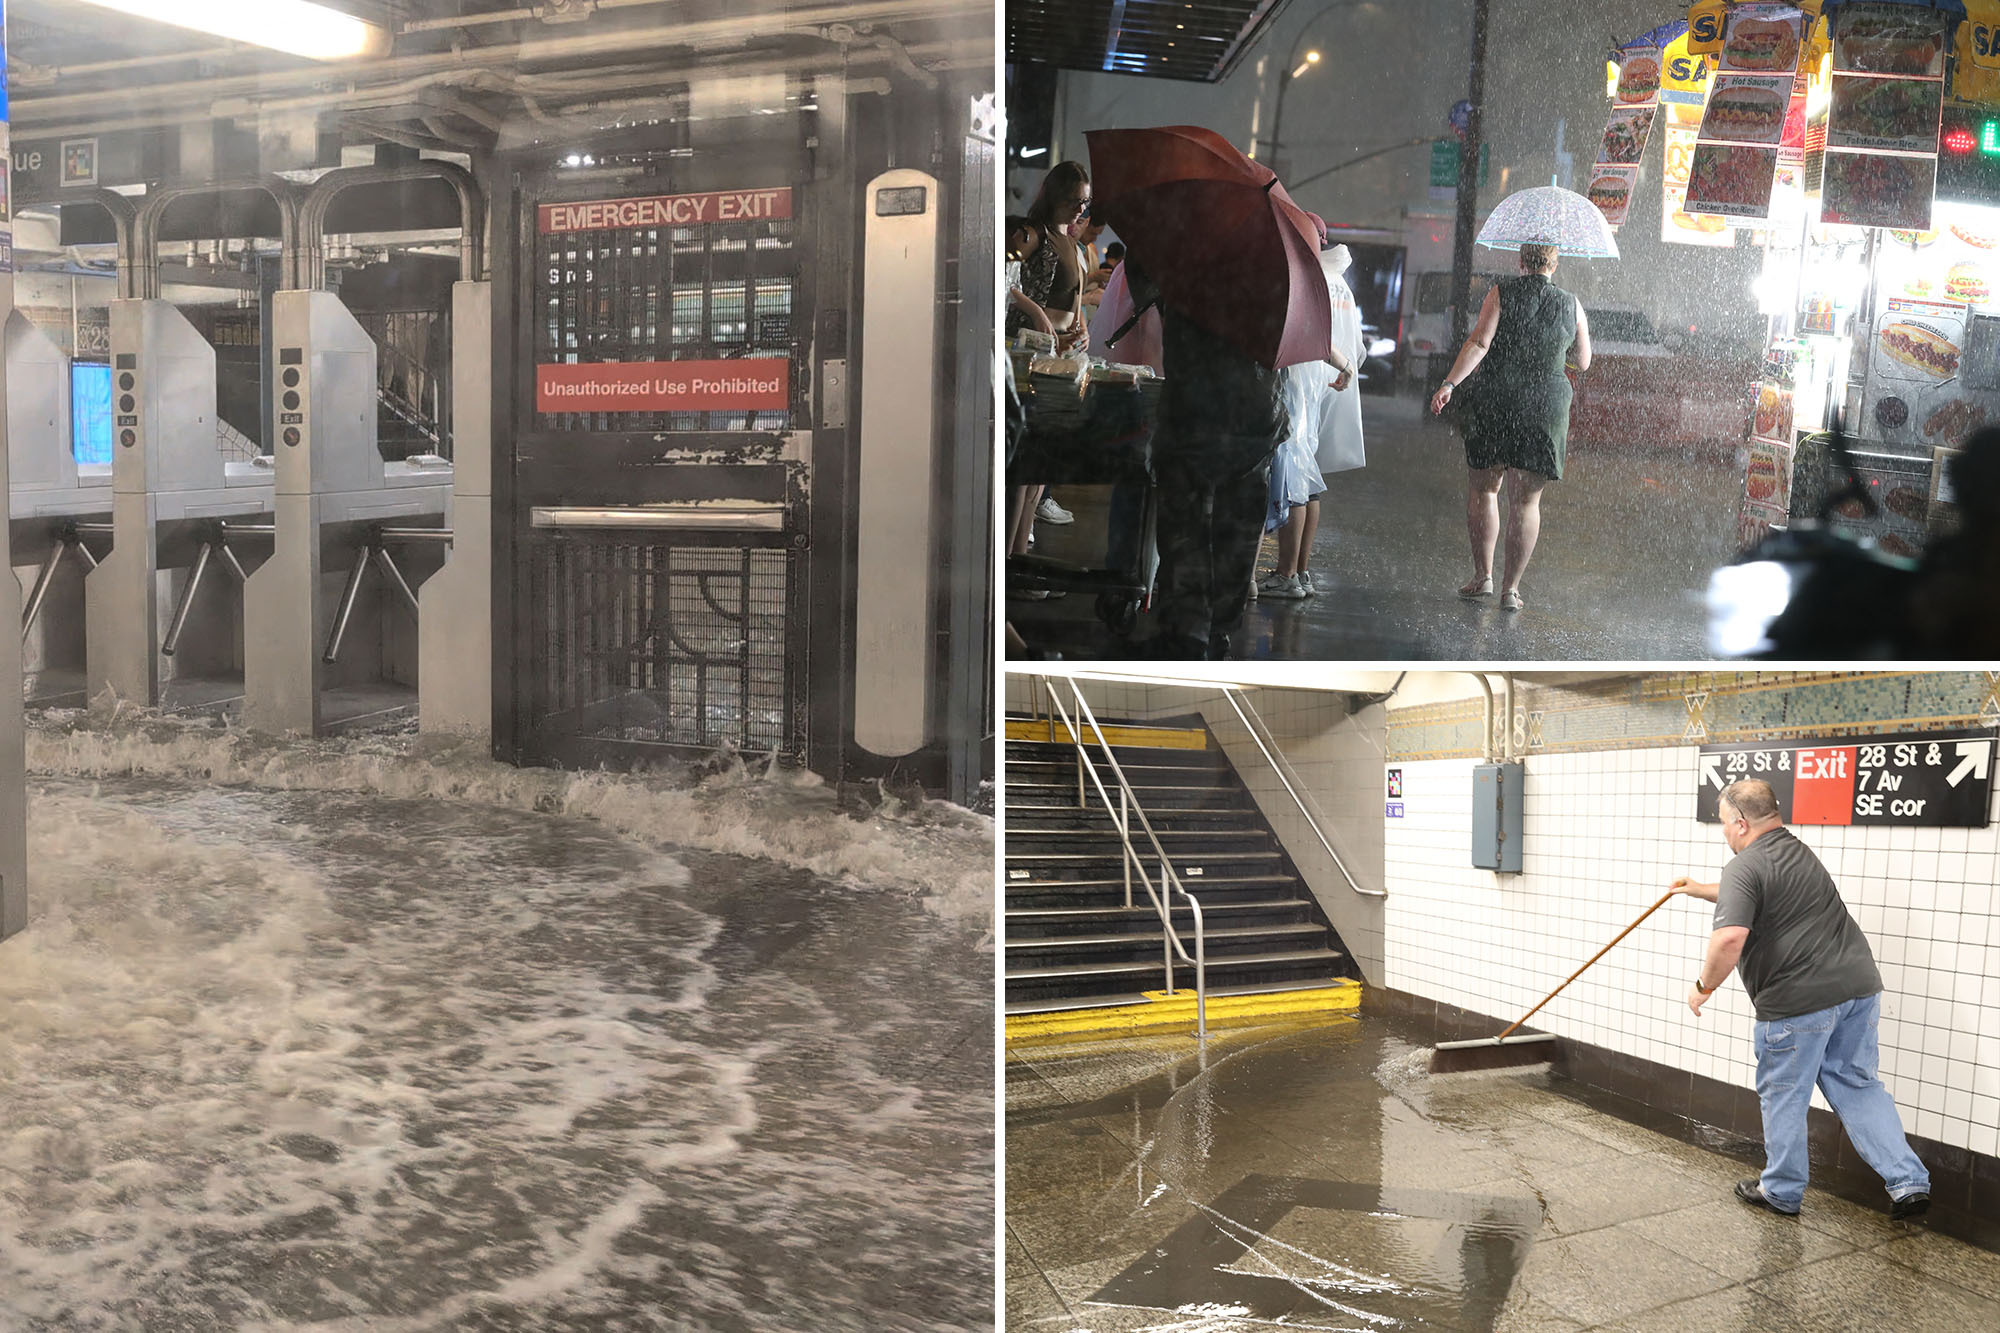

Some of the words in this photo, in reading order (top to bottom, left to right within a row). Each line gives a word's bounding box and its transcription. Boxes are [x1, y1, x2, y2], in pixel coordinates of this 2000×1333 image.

[1731, 76, 1745, 86] Hot
[1747, 77, 1779, 88] Sausage
[1898, 140, 1918, 149] Rice
[551, 197, 707, 231] EMERGENCY
[718, 192, 778, 219] EXIT
[1696, 202, 1721, 212] Chicken
[544, 380, 650, 397] Unauthorized
[655, 379, 687, 395] Use
[691, 378, 780, 394] Prohibited
[1726, 753, 1747, 772] 28
[1753, 752, 1772, 771] St
[1777, 752, 1791, 771] &
[1796, 750, 1848, 780] Exit
[1858, 746, 1887, 768] 28
[1893, 744, 1918, 767] St
[1925, 743, 1943, 766] &
[1858, 770, 1872, 792] 7
[1876, 770, 1903, 791] Av
[1855, 795, 1885, 816] SE
[1889, 798, 1926, 817] cor
